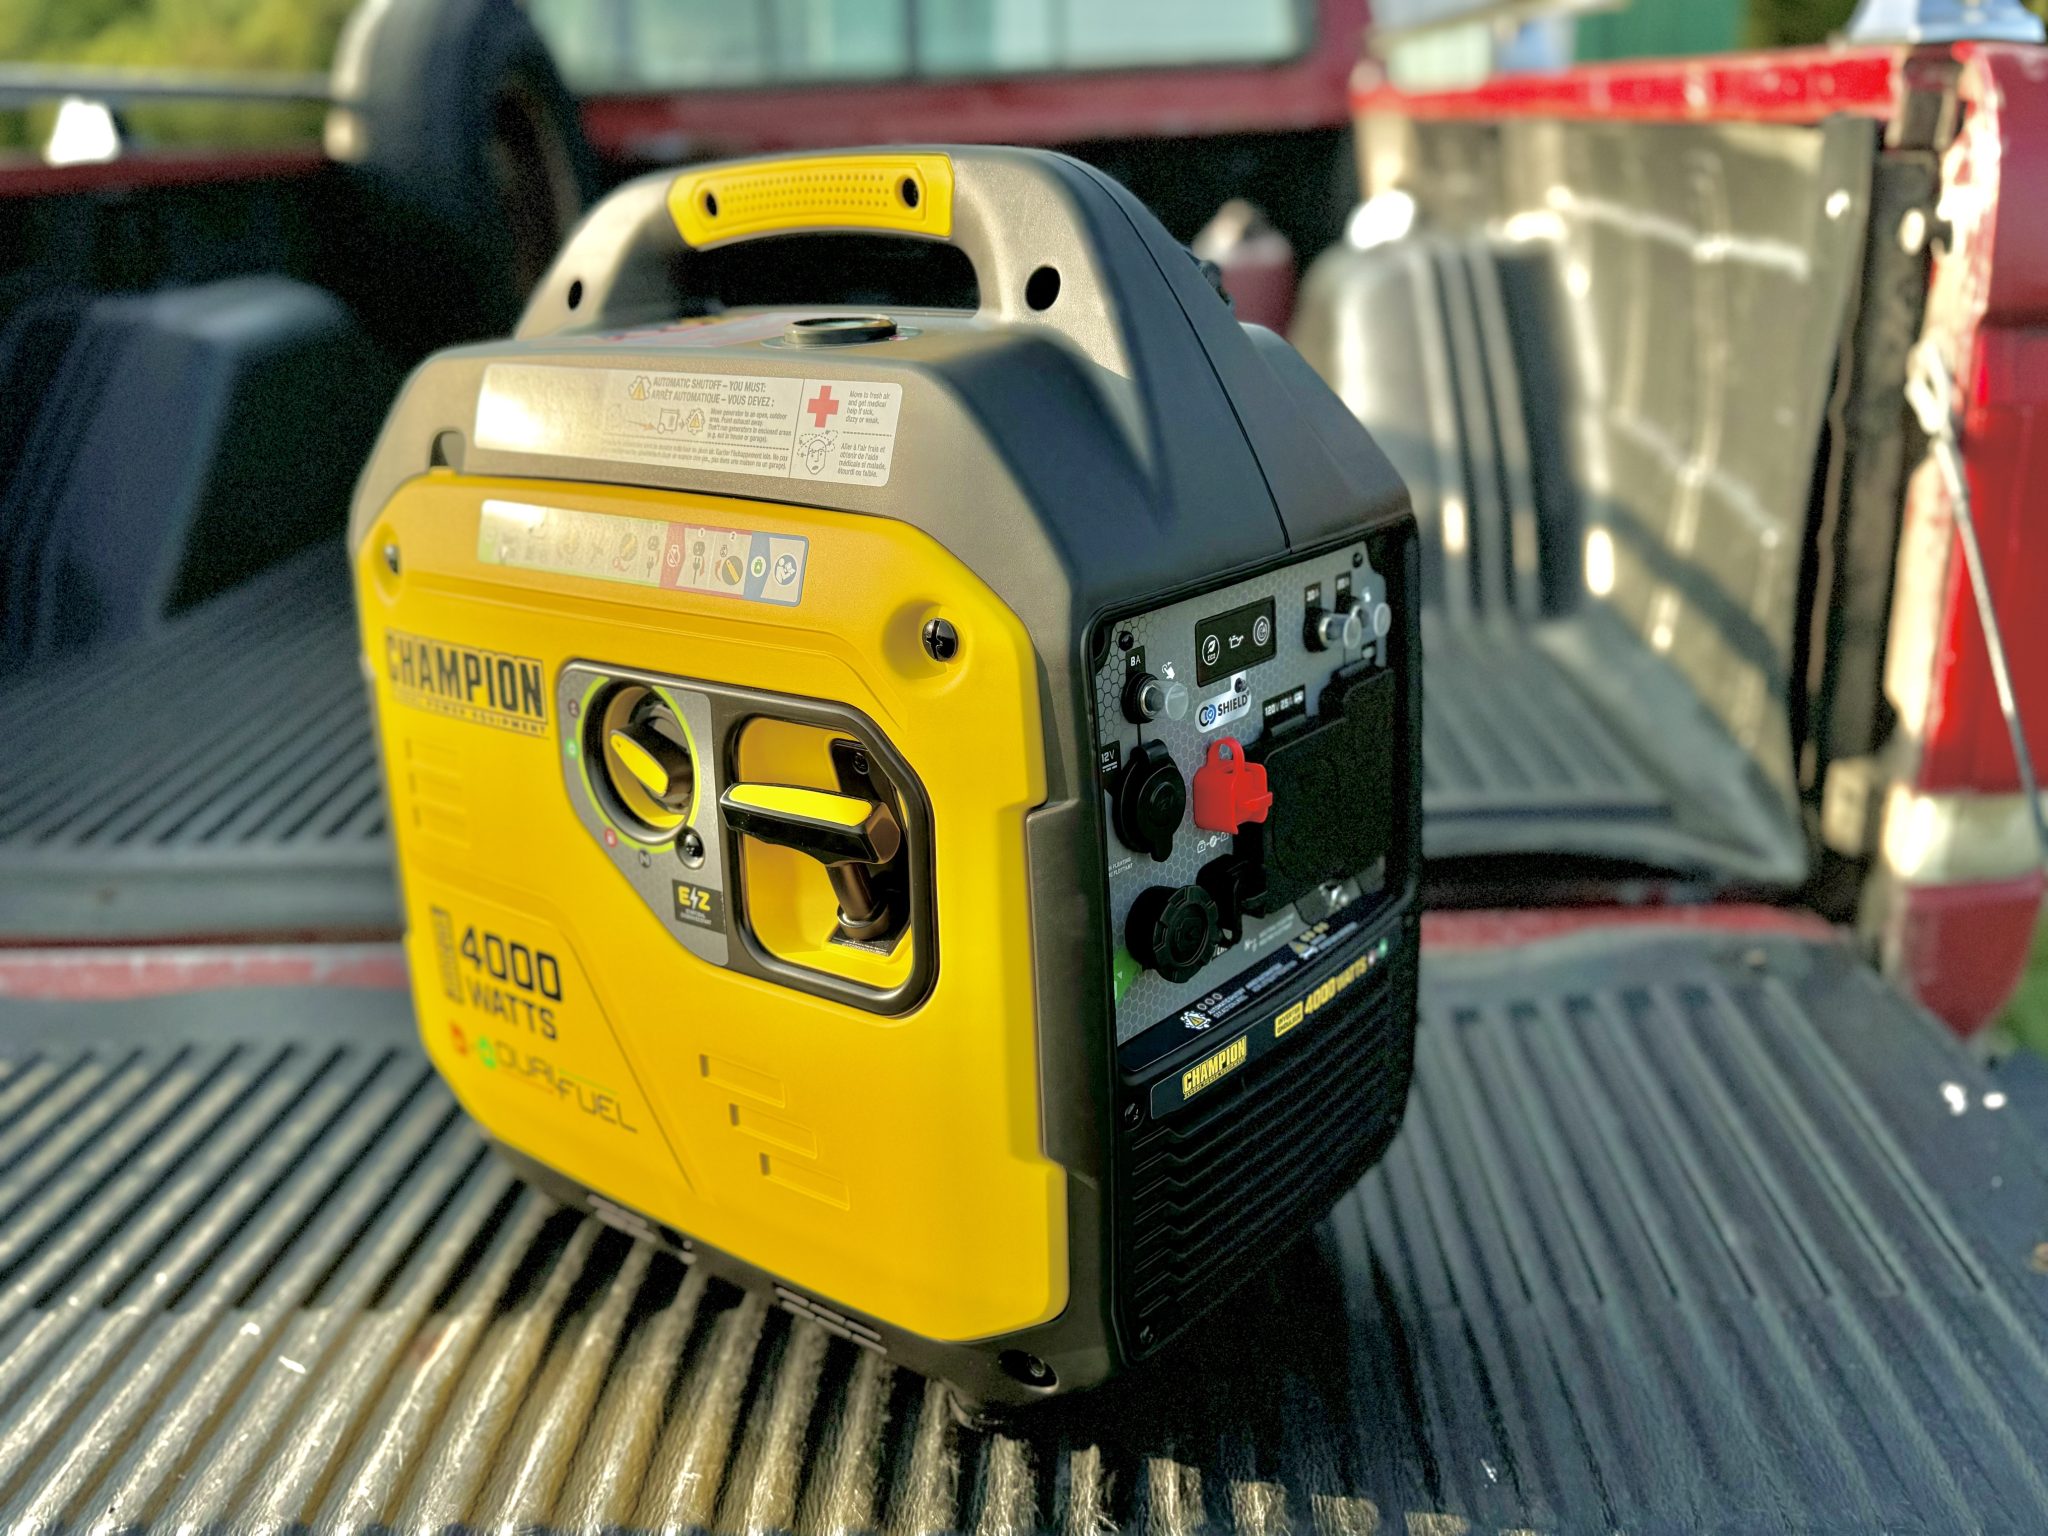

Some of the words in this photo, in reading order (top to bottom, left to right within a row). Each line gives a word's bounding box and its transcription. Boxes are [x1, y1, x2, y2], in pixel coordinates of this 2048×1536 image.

[691, 379, 722, 391] SHUTOFF
[729, 381, 743, 392] YOU
[727, 394, 746, 406] VOUS
[387, 633, 543, 718] CHAMPION
[1218, 694, 1248, 717] SHIELD
[1101, 750, 1115, 763] 12V
[462, 926, 562, 1002] 4000
[467, 975, 558, 1041] WATTS
[1305, 977, 1336, 1014] 4000
[1183, 1038, 1246, 1093] CHAMPION
